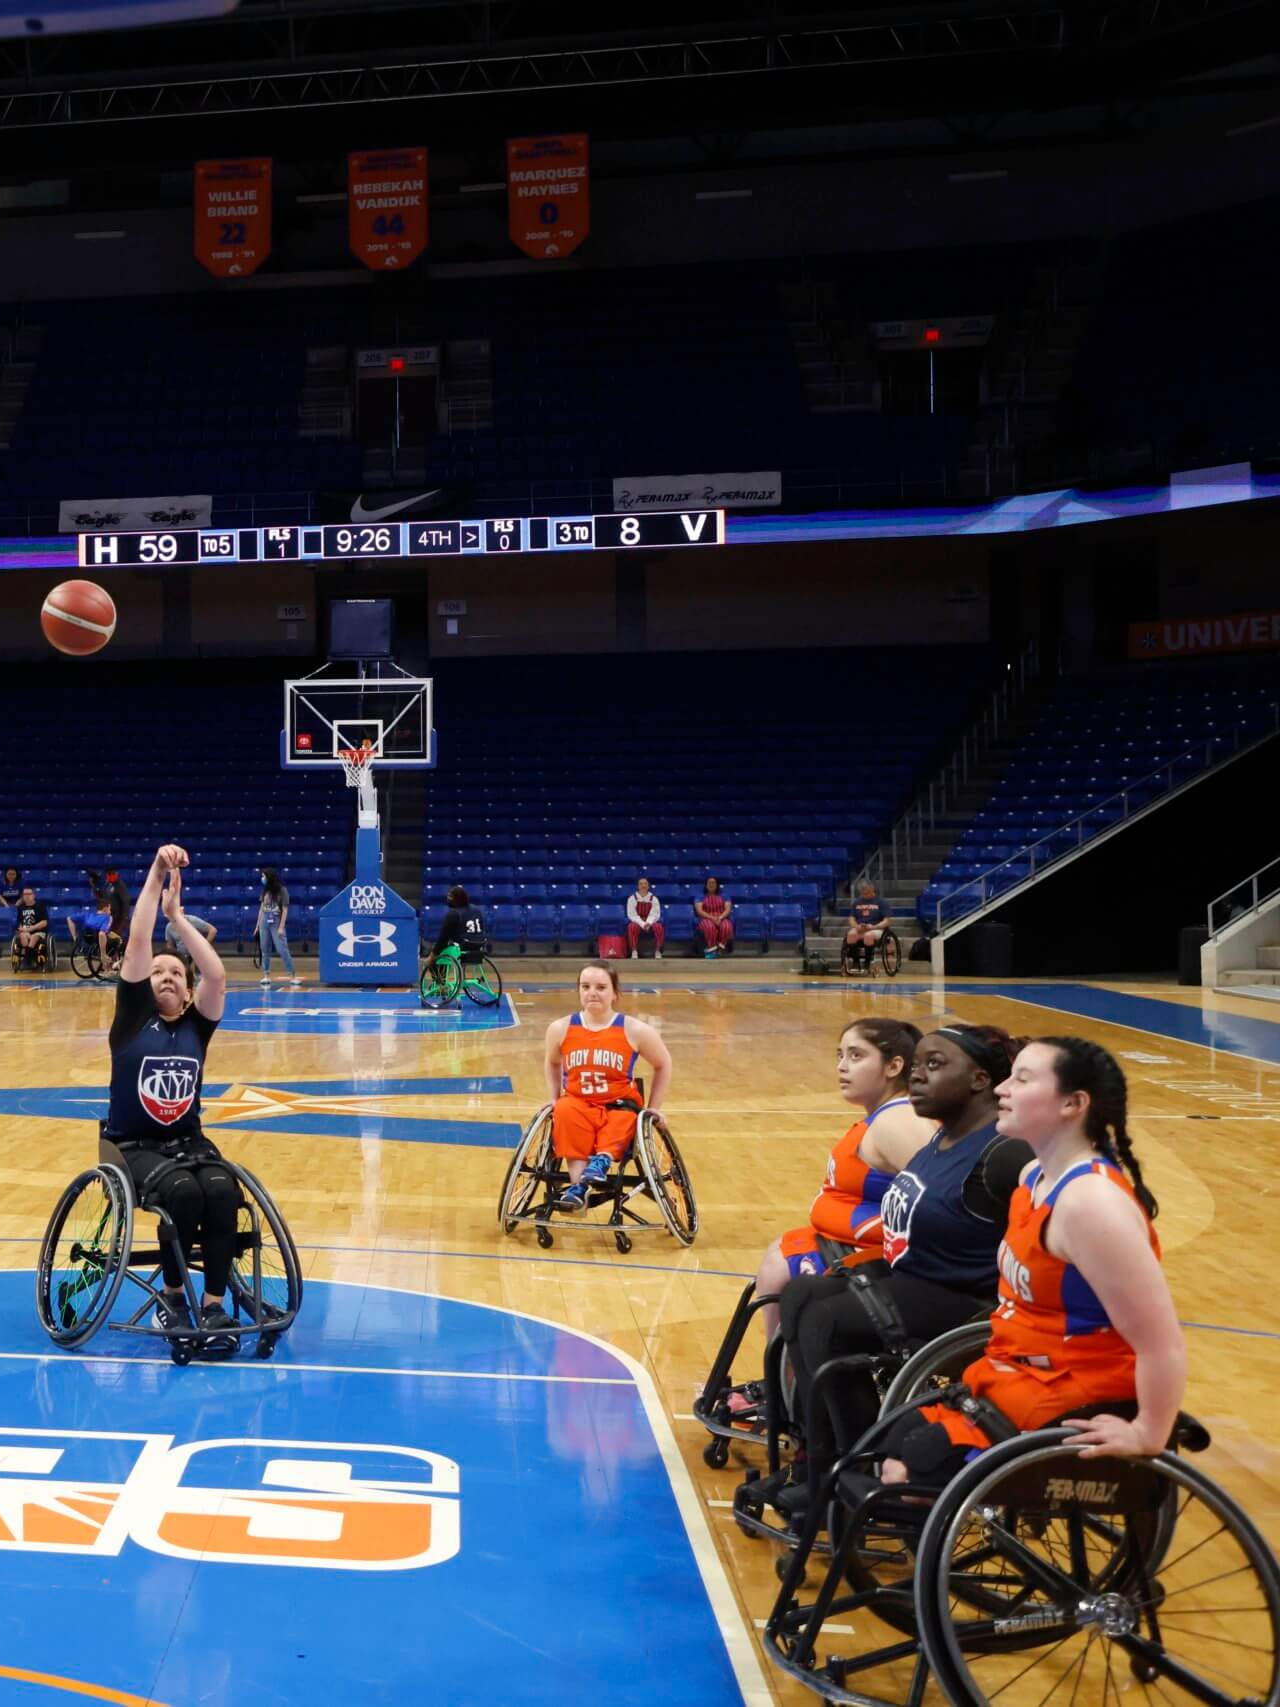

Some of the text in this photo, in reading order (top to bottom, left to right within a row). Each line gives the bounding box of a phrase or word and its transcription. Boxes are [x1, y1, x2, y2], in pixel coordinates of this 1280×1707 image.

[510, 166, 586, 182] MARQUEZ
[353, 179, 424, 195] REBEKAH
[517, 183, 579, 198] HAYNES
[207, 189, 257, 202] WILLIE
[207, 204, 259, 218] BRAND
[539, 202, 559, 225] 0
[218, 223, 246, 245] 22
[493, 520, 514, 532] FLS
[620, 514, 707, 545] 8 V
[269, 528, 291, 541] FLS
[336, 528, 391, 552] 9:26
[418, 530, 452, 547] 4TH
[499, 534, 510, 550] 0
[94, 534, 177, 563] H 59
[278, 543, 285, 558] 1
[351, 885, 384, 898] DON
[349, 897, 386, 910] DAVIS
[466, 918, 482, 933] 31
[565, 1048, 624, 1072] LADY MAVS
[580, 1071, 609, 1095] 55
